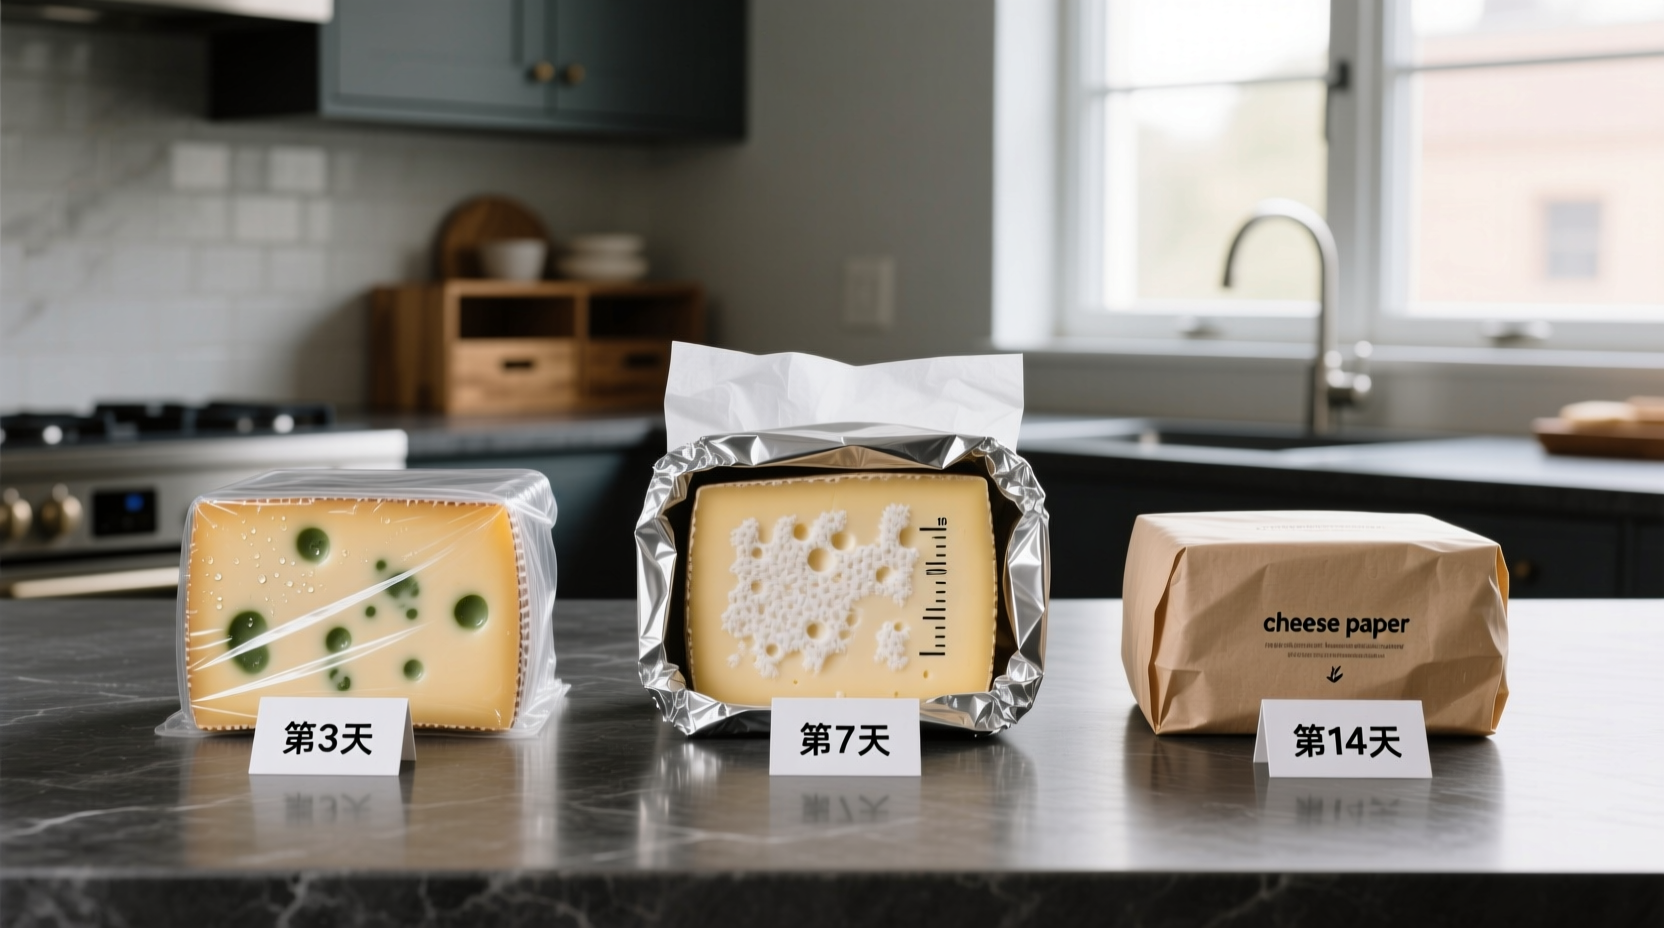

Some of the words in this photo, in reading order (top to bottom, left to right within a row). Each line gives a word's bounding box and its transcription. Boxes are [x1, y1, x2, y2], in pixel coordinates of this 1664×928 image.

[1263, 611, 1341, 633] cheese
[1345, 616, 1411, 639] paper
[282, 721, 373, 756] 第3天
[800, 722, 891, 757] 第7天
[1293, 723, 1403, 759] 第14天
